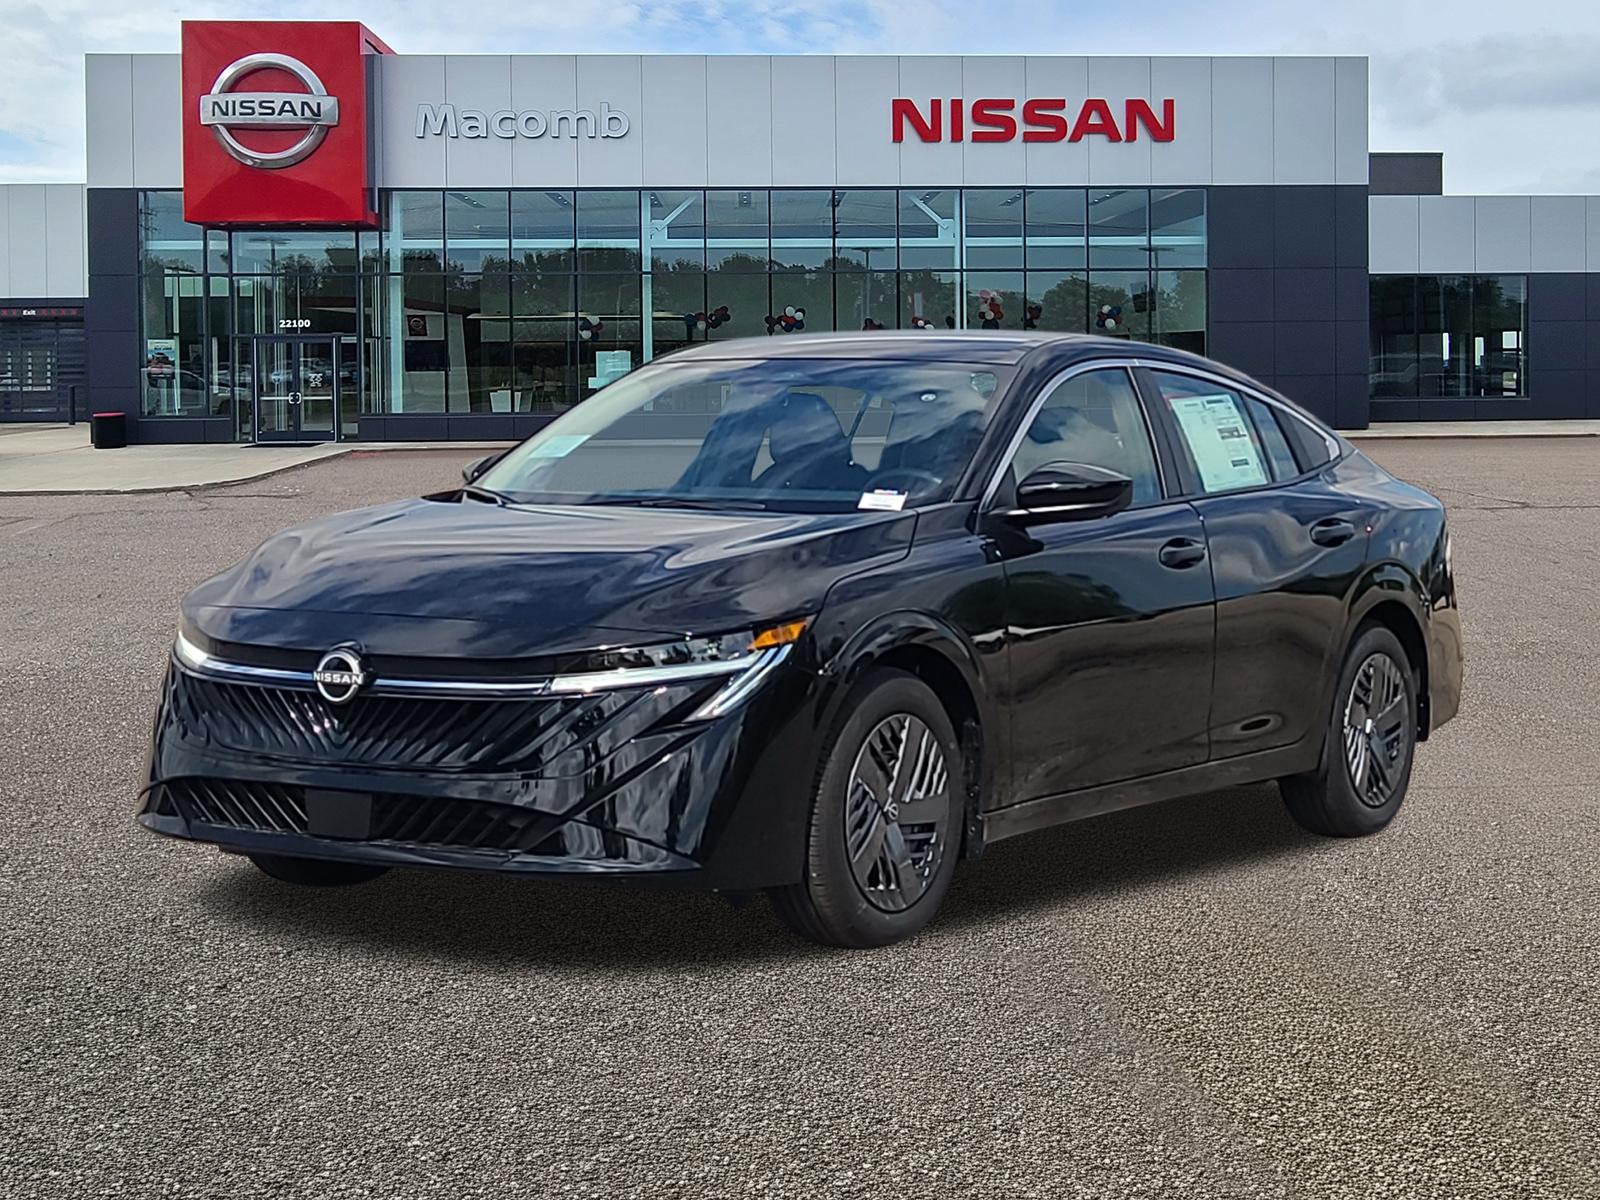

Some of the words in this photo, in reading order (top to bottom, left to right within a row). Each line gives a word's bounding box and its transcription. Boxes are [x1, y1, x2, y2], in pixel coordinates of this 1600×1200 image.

[212, 100, 322, 117] NISSAN
[415, 101, 630, 139] Macomb
[892, 98, 1176, 143] NISSAN
[279, 319, 311, 328] 22100
[313, 671, 364, 685] NISSAN
